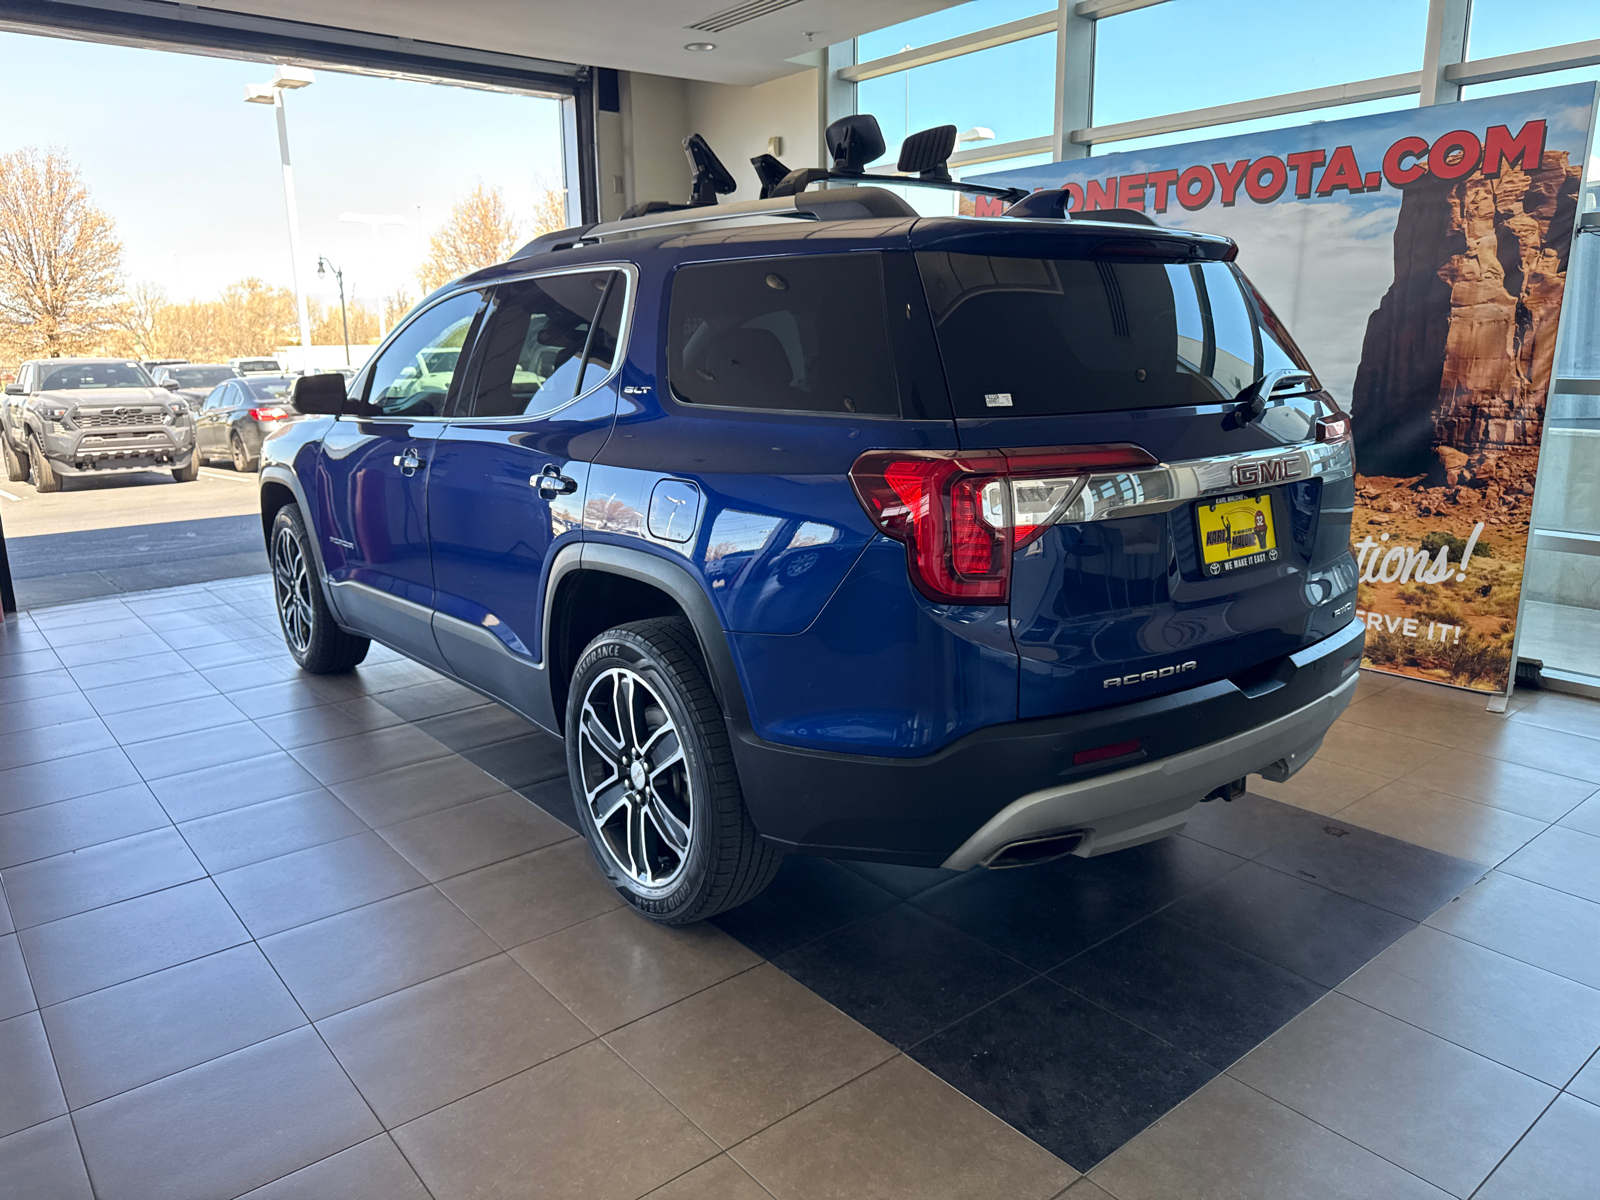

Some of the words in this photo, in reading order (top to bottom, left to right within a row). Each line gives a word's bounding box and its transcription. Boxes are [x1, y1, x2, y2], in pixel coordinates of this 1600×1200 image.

[975, 119, 1546, 217] MONETOYOTA.COM
[624, 386, 652, 394] SLT
[1232, 456, 1302, 486] GMC
[1224, 562, 1233, 571] WE
[1234, 559, 1247, 569] MAKE
[1248, 556, 1253, 565] IT
[1254, 553, 1266, 564] EASY
[1428, 622, 1461, 645] IT!
[1103, 660, 1197, 689] ACADIA
